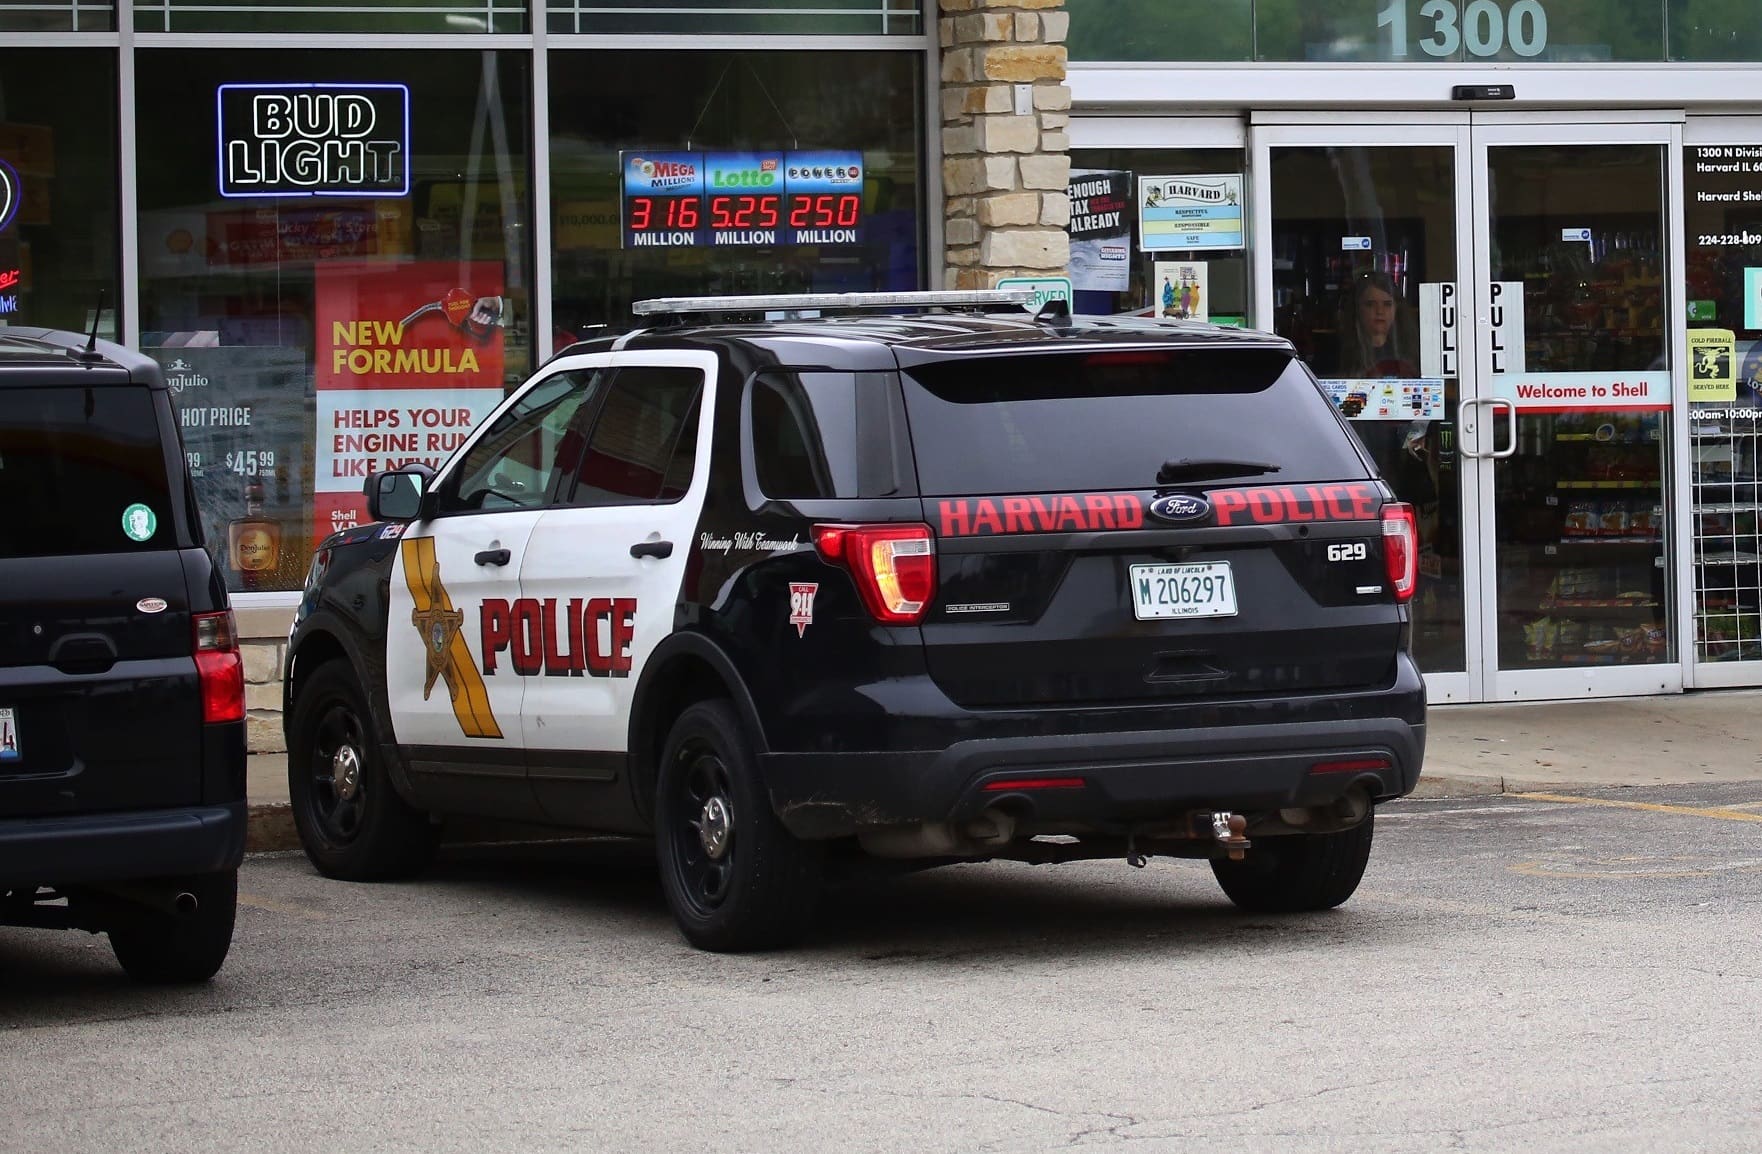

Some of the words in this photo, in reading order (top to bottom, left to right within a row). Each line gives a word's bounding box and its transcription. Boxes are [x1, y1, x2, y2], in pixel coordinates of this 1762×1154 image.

[1377, 0, 1547, 57] 1300
[253, 94, 376, 139] BUD
[228, 139, 401, 185] LIGHT
[1697, 148, 1722, 157] 1300
[1724, 148, 1733, 157] N
[653, 162, 695, 177] MEGA
[1697, 162, 1740, 172] Harvard
[1743, 162, 1751, 172] IL
[651, 177, 695, 187] MILLIONS
[714, 170, 776, 188] Lotto
[1067, 180, 1111, 199] ENOUGH
[1169, 185, 1221, 200] HARVARD
[1697, 191, 1740, 202] Harvard
[631, 198, 698, 229] 316
[712, 197, 778, 227] 5.25
[790, 196, 859, 226] 250
[1070, 200, 1089, 216] TAX
[1071, 212, 1120, 233] ALREADY
[634, 231, 695, 246] MILLION
[715, 231, 775, 245] MILLION
[796, 230, 856, 244] MILLION
[333, 321, 404, 346] NEW
[1441, 284, 1455, 375] PULL
[1490, 283, 1504, 373] PULL
[333, 348, 480, 375] FORMULA
[1517, 383, 1586, 398] Welcome
[1592, 385, 1606, 397] to
[1612, 382, 1648, 397] Shell
[181, 408, 207, 427] HOT
[210, 407, 251, 426] PRICE
[334, 409, 400, 428] HELPS
[407, 408, 472, 428] YOUR
[333, 433, 418, 453] ENGINE
[333, 458, 378, 477] LIKE
[331, 510, 356, 520] Shell
[1165, 500, 1198, 515] Ford
[1209, 484, 1377, 527] POLICE
[938, 494, 1144, 538] HARVARD
[700, 532, 733, 556] Winning
[734, 531, 755, 550] With
[755, 531, 799, 551] Teamwork
[1327, 543, 1367, 562] 629
[478, 597, 638, 677] POLICE
